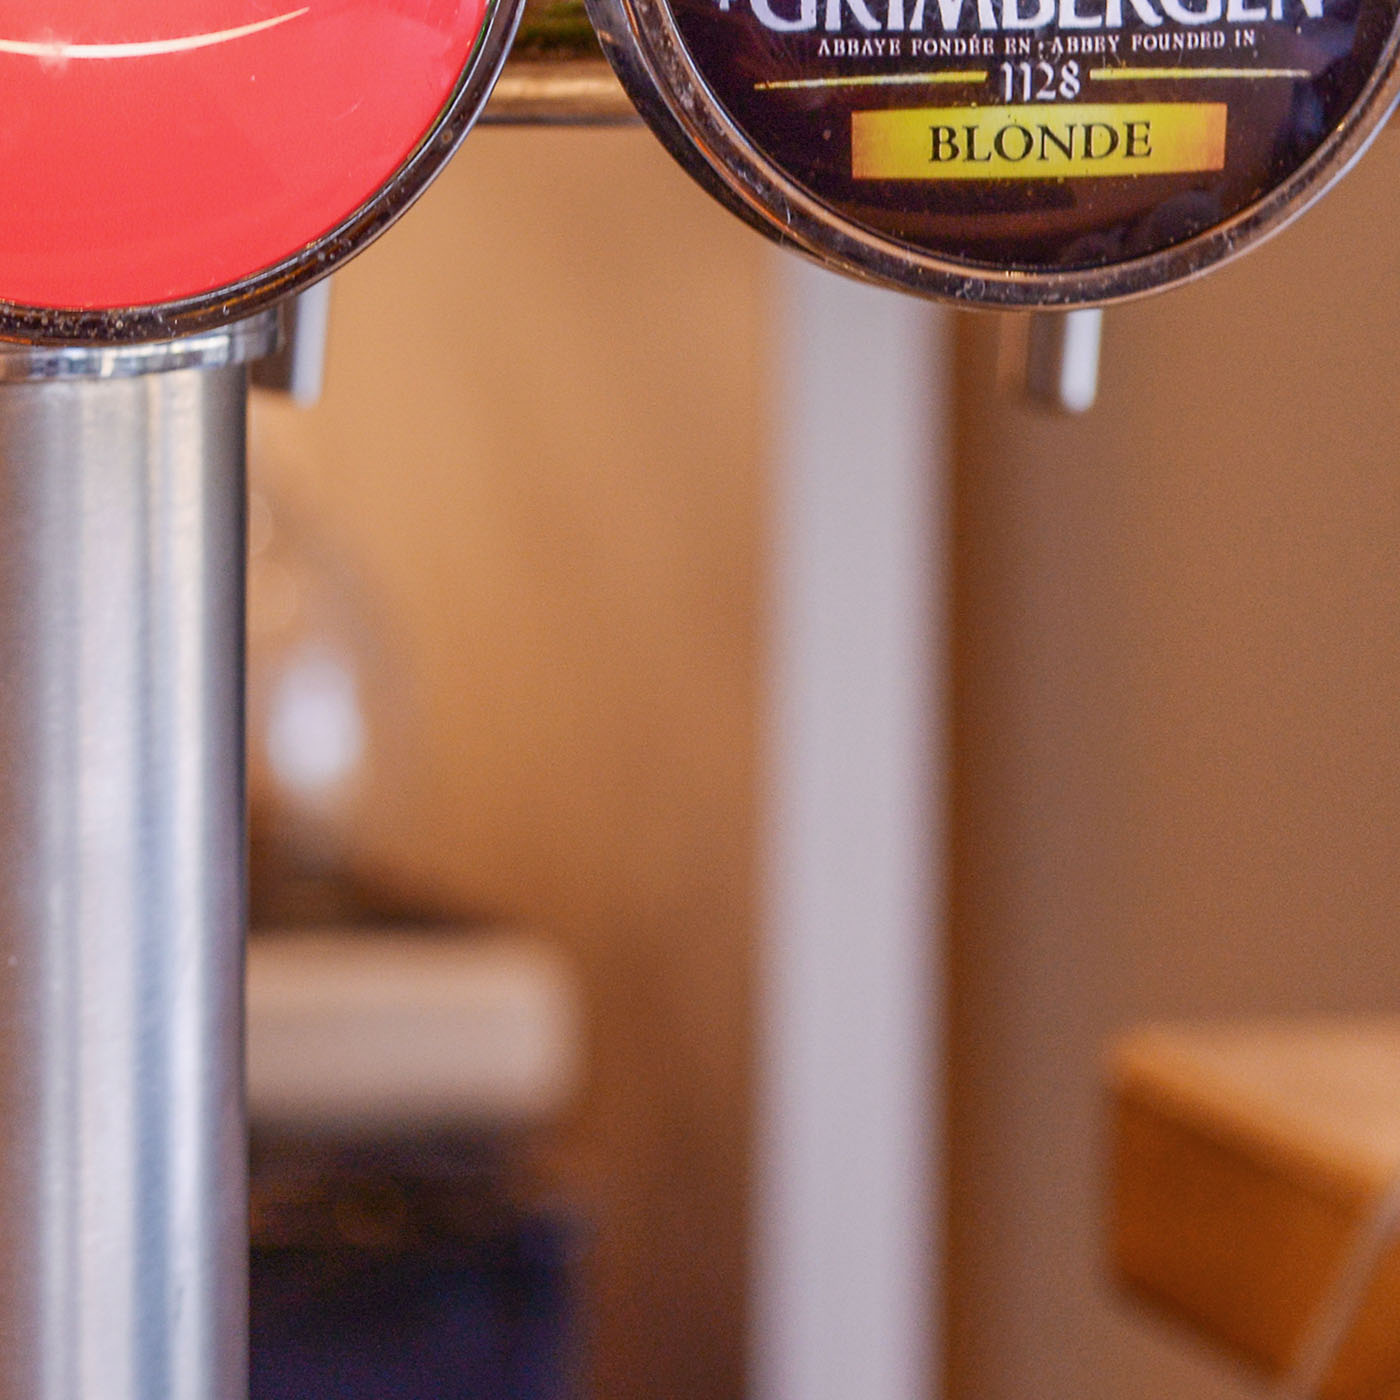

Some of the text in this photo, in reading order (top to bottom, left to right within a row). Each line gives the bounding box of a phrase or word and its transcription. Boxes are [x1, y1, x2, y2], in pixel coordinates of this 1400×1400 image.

[818, 38, 901, 58] ABBAYE
[911, 34, 995, 56] FONDÉE
[1051, 34, 1121, 55] ABBEY
[1131, 29, 1227, 52] FOUNDED
[1234, 29, 1256, 48] IN
[1000, 60, 1081, 102] 1128
[928, 120, 1154, 163] BLONDE
